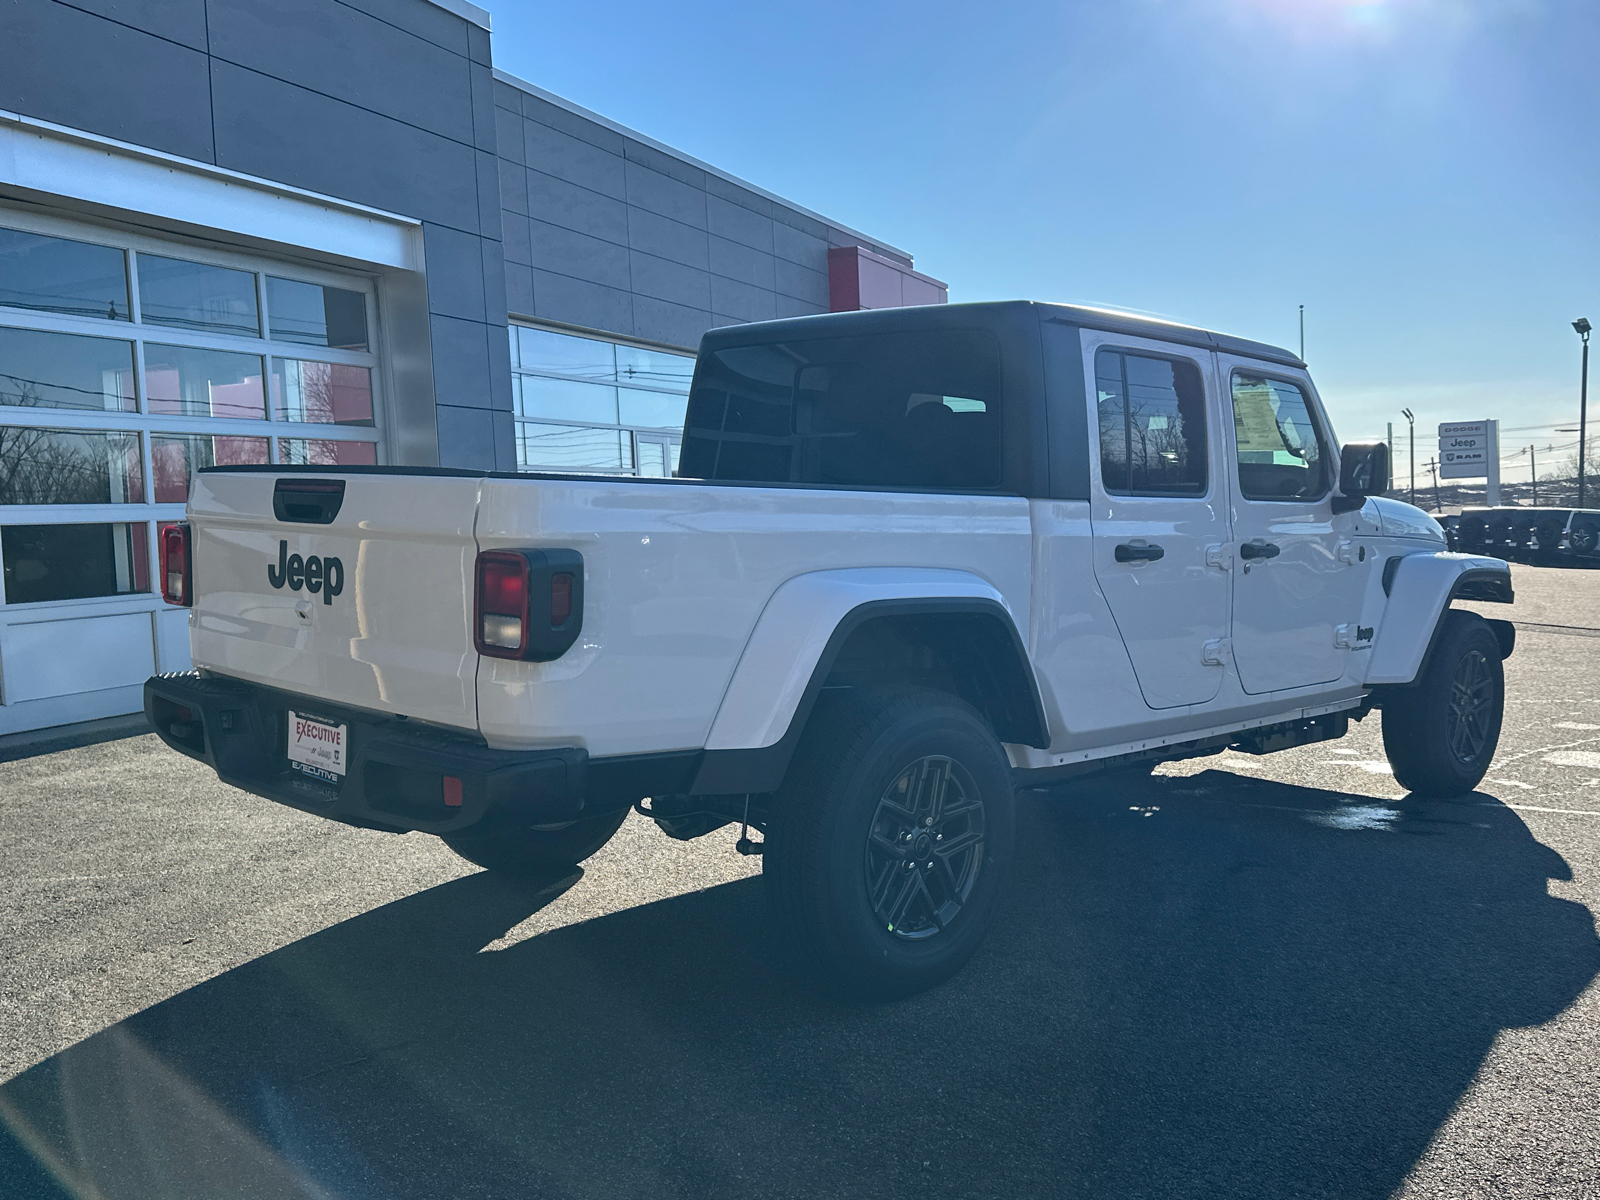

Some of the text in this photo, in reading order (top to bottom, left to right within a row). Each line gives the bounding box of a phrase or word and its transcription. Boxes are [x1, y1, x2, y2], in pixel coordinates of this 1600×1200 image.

[1450, 438, 1476, 448] Jeep
[267, 539, 345, 606] Jeep
[296, 720, 341, 746] EXECUTIVE
[292, 761, 338, 782] EXECUTIVE
